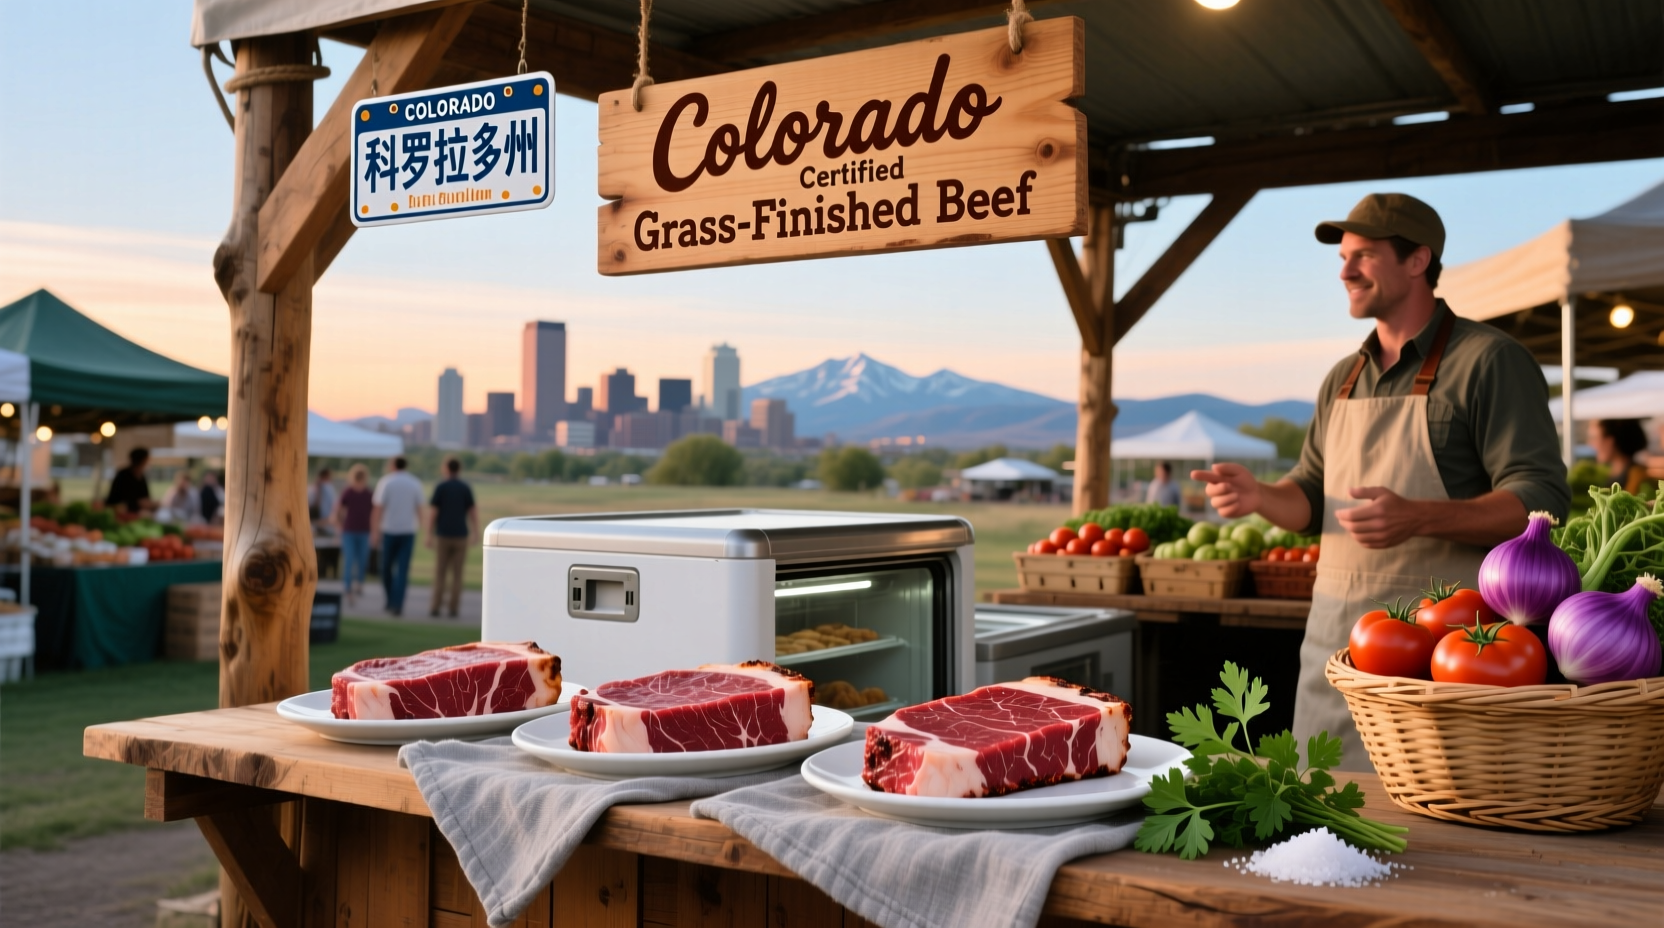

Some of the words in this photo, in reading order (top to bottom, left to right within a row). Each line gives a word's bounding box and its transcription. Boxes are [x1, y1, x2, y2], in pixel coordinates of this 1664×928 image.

[405, 92, 495, 120] COLORADO
[653, 54, 1002, 192] Colorado
[364, 117, 538, 193] 科罗拉多州
[800, 156, 904, 188] Certified
[634, 184, 920, 251] Grass-Finished
[937, 170, 1037, 223] Beef
